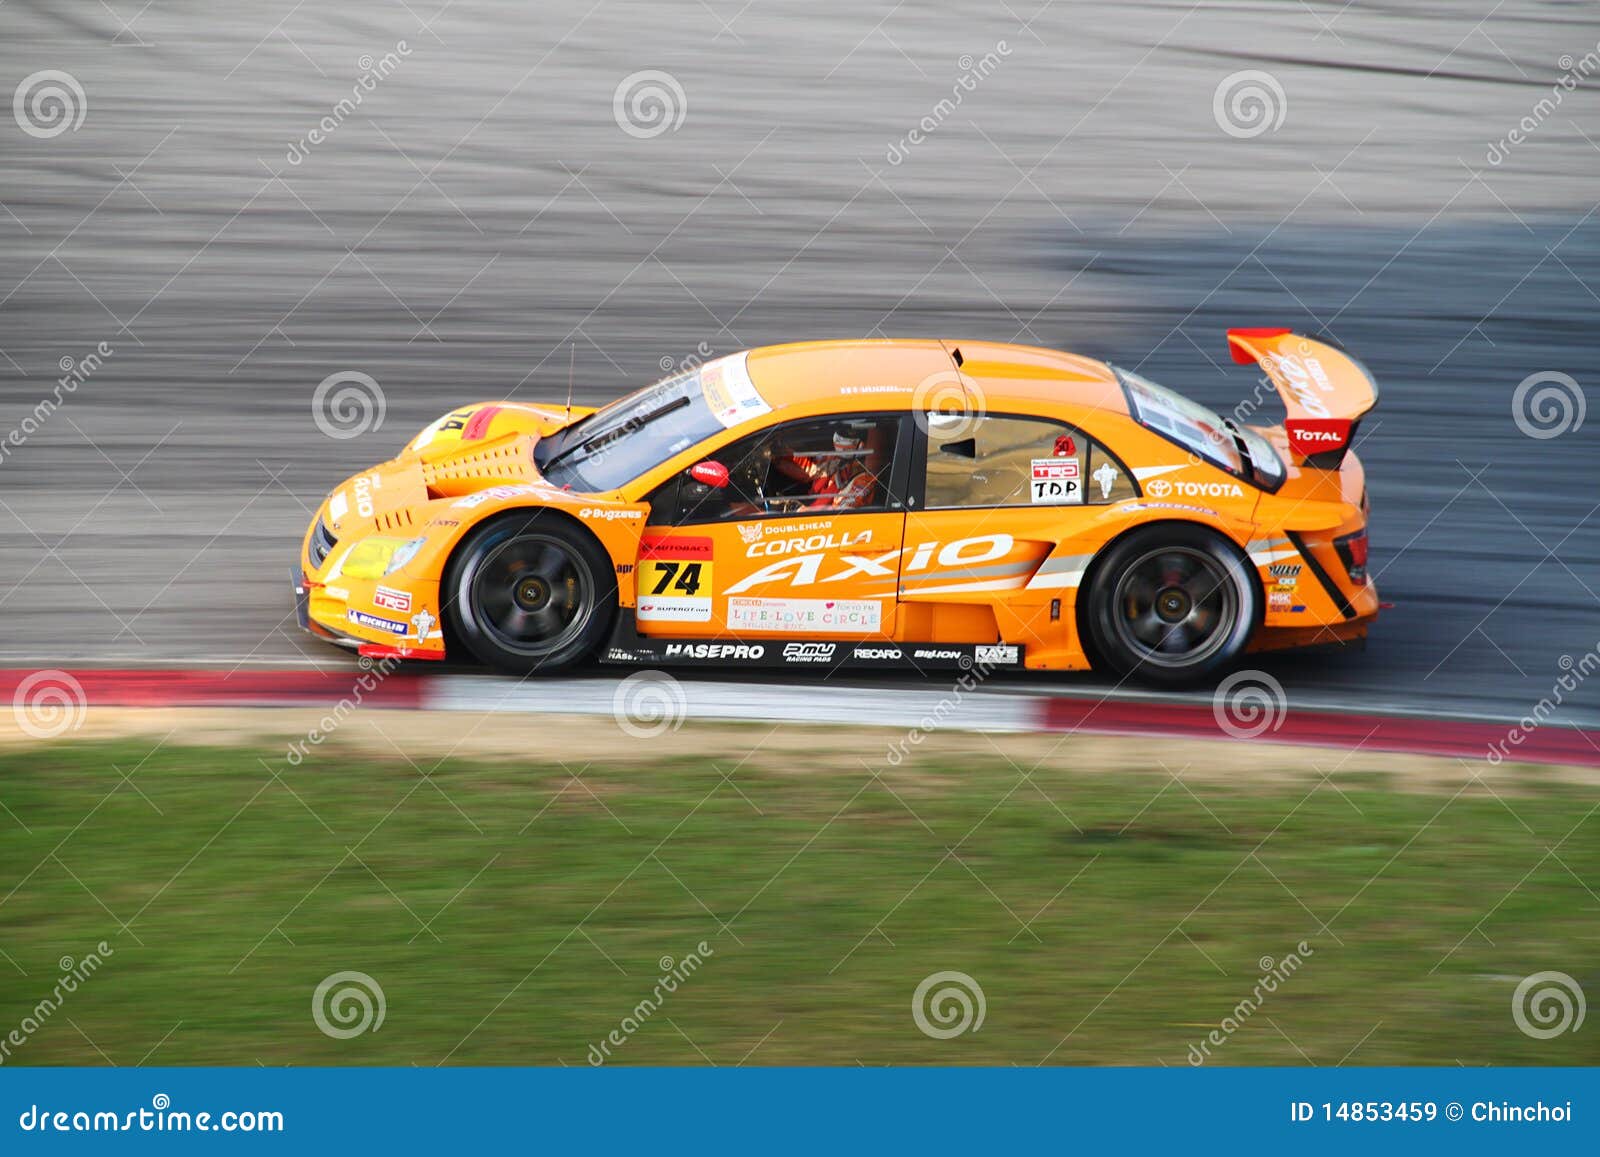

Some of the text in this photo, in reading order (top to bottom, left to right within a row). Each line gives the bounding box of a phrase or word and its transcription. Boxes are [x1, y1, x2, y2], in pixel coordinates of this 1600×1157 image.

[1293, 429, 1342, 442] TOTAL
[1174, 482, 1244, 497] TOYOTA
[745, 530, 873, 558] COROLLA
[616, 564, 634, 574] apr
[651, 562, 702, 596] 74
[359, 614, 405, 633] MICHELIN
[822, 611, 878, 625] CIRCLE
[665, 644, 764, 660] HASEPRO
[853, 648, 902, 660] RECARO
[975, 645, 1018, 659] RAYS
